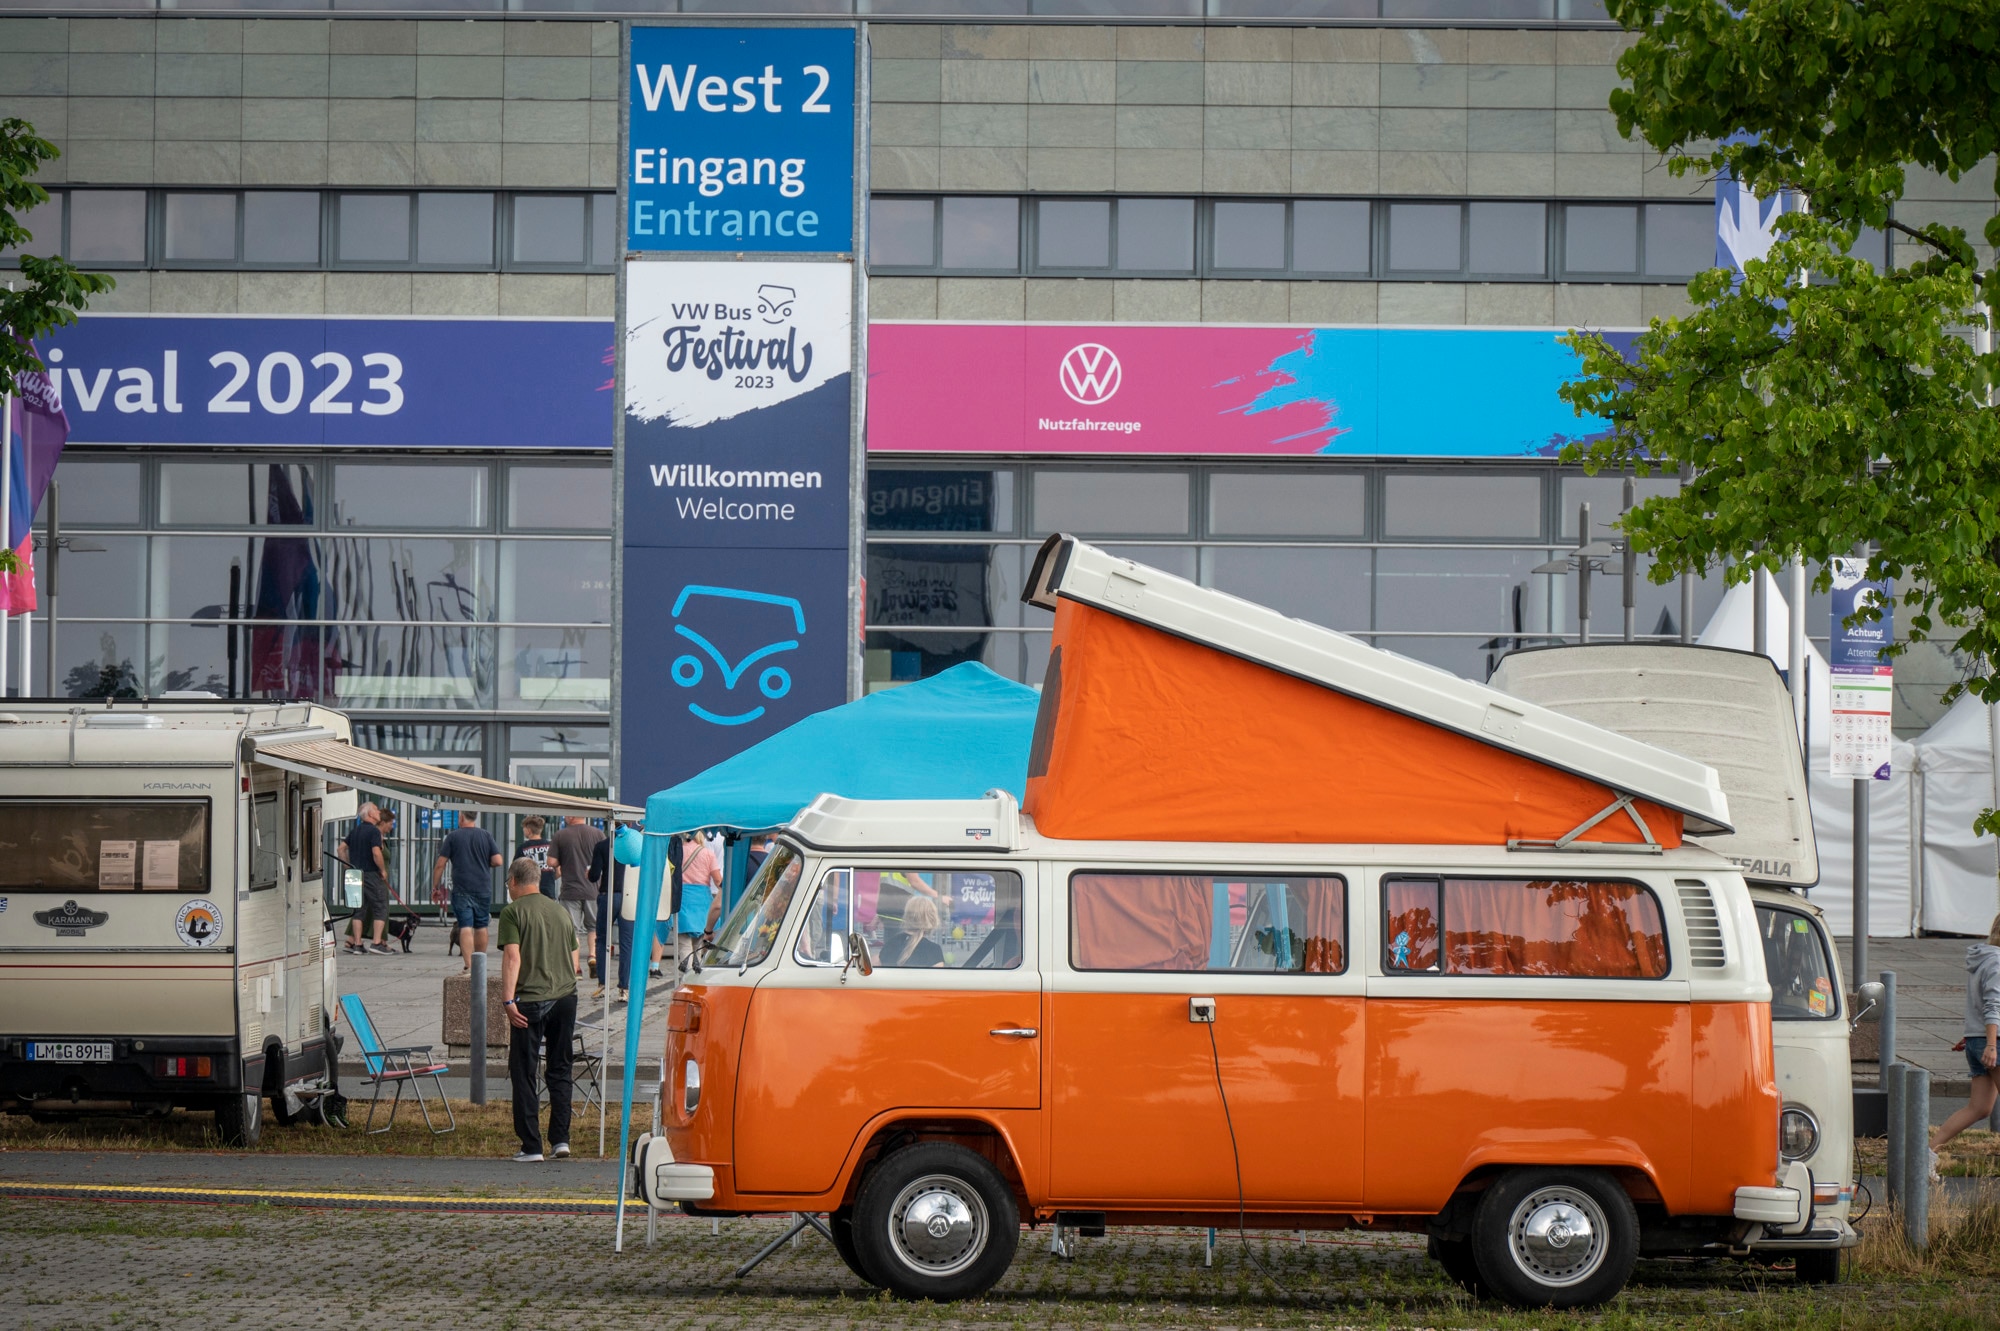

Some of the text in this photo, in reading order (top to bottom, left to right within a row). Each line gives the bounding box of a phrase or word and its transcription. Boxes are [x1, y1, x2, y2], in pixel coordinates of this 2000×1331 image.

[636, 64, 831, 113] West 2
[635, 148, 806, 198] Eingang
[634, 200, 819, 237] Entrance
[671, 303, 752, 320] VW Bus
[662, 325, 813, 383] Festival
[208, 351, 404, 416] 2023
[734, 376, 775, 389] 2023
[1038, 418, 1142, 434] Nutzfahrzeuge
[650, 464, 822, 488] Willkommen
[676, 497, 795, 520] Welcome
[1847, 627, 1883, 640] Achtung!
[1847, 647, 1880, 658] Attentio
[143, 782, 211, 790] KARMANN
[1725, 857, 1791, 877] TFALIA
[48, 916, 93, 925] KARMANN
[36, 1045, 55, 1059] LM
[64, 1045, 73, 1059] G
[75, 1045, 103, 1059] 89H
